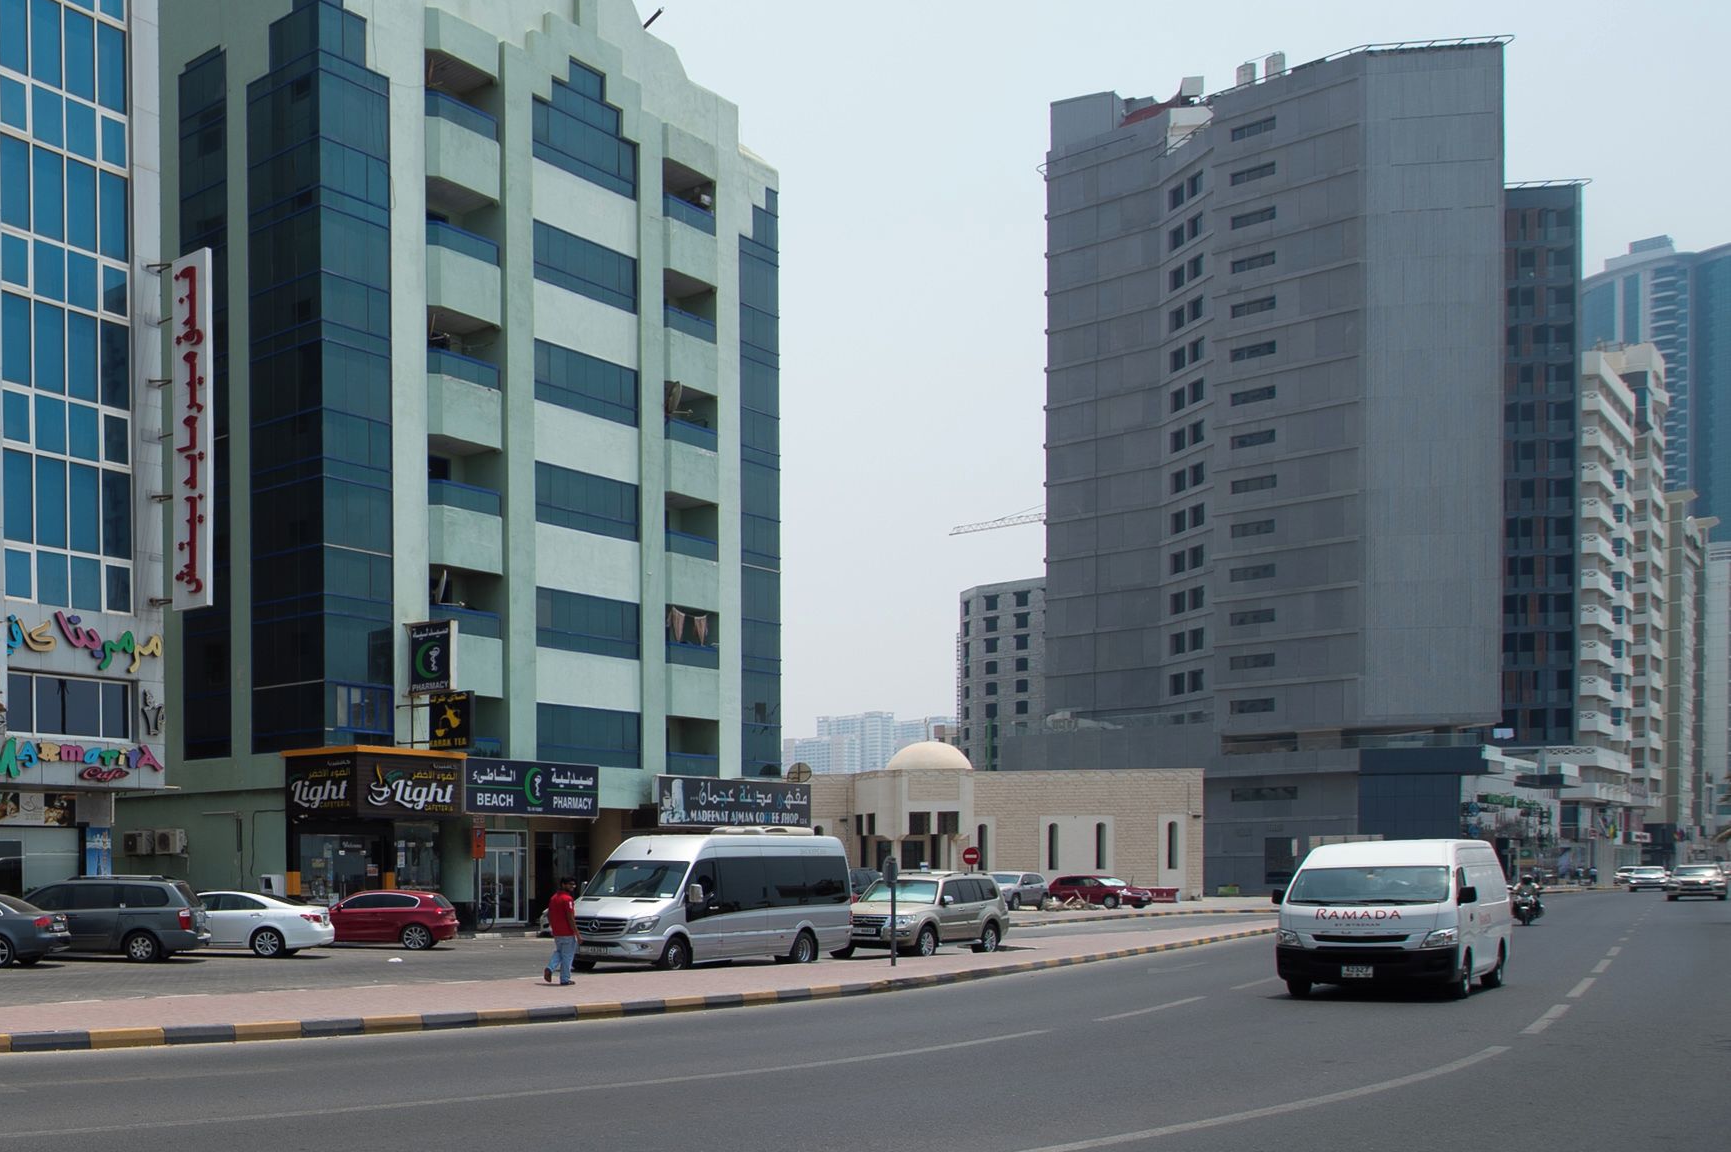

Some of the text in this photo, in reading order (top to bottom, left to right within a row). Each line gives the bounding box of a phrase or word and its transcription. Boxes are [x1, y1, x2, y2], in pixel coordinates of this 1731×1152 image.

[173, 265, 205, 594] فندق ميرمايد بيتش
[412, 628, 449, 640] صيدلية
[411, 679, 449, 692] PHARMACY
[454, 736, 467, 746] TEA
[81, 766, 128, 782] Cafe
[551, 767, 594, 789] صيدلية
[291, 779, 348, 809] Light
[391, 779, 454, 810] Light
[476, 792, 514, 807] BEACH
[553, 796, 593, 810] PHARMACY
[698, 781, 735, 807] عجمان
[740, 784, 772, 808] مدينة
[320, 800, 351, 809] CAFETERIA
[424, 803, 454, 812] CAFETERIA
[690, 809, 729, 823] MADEENAT
[730, 811, 754, 825] AJMAN
[780, 813, 799, 825] SHOP
